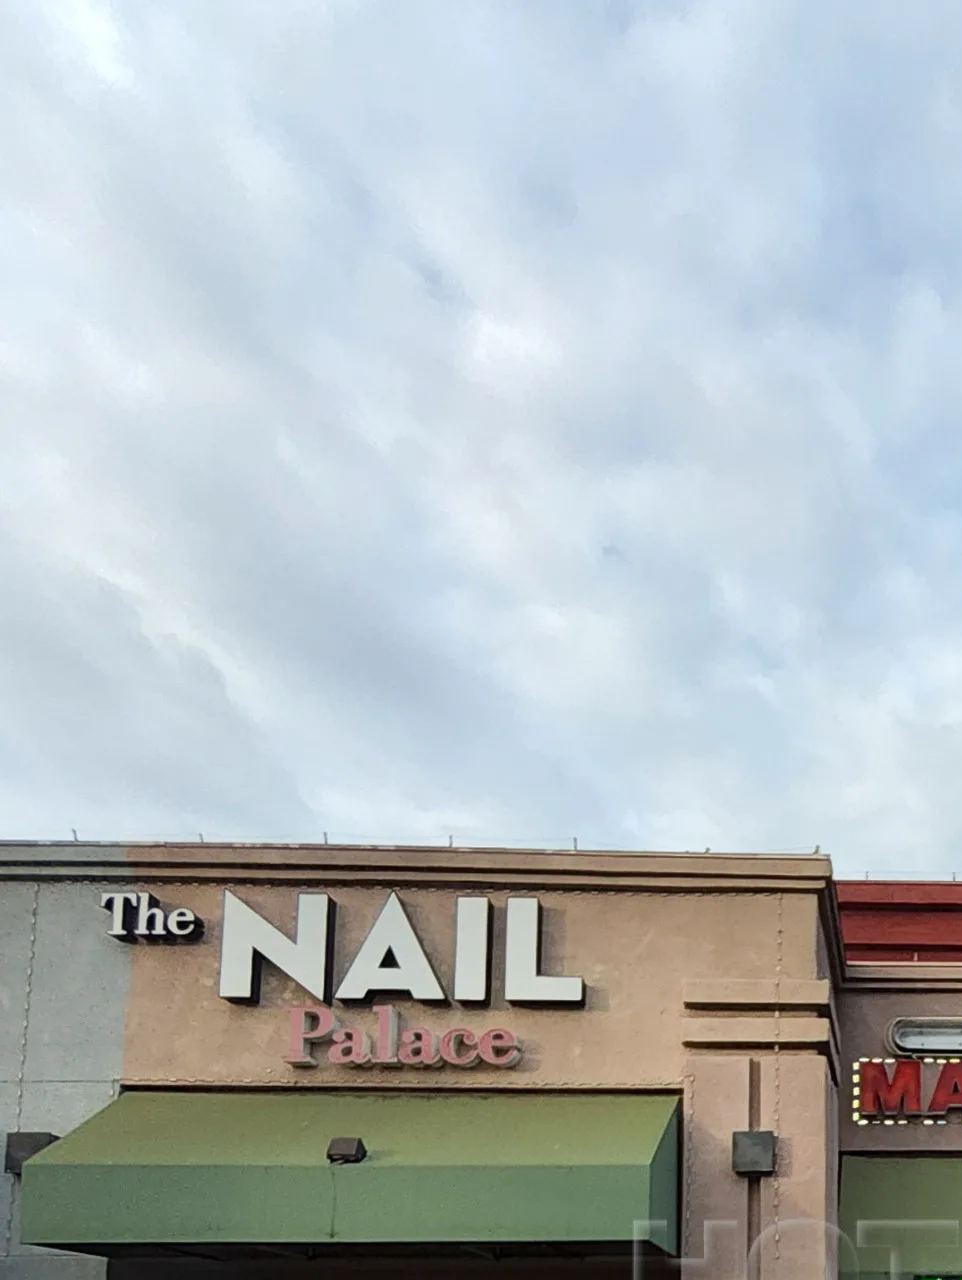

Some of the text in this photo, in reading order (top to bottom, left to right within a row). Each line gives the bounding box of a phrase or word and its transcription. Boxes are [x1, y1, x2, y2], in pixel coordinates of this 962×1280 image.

[102, 892, 197, 937] The
[218, 889, 584, 1002] NAIL
[287, 1005, 520, 1066] Palace
